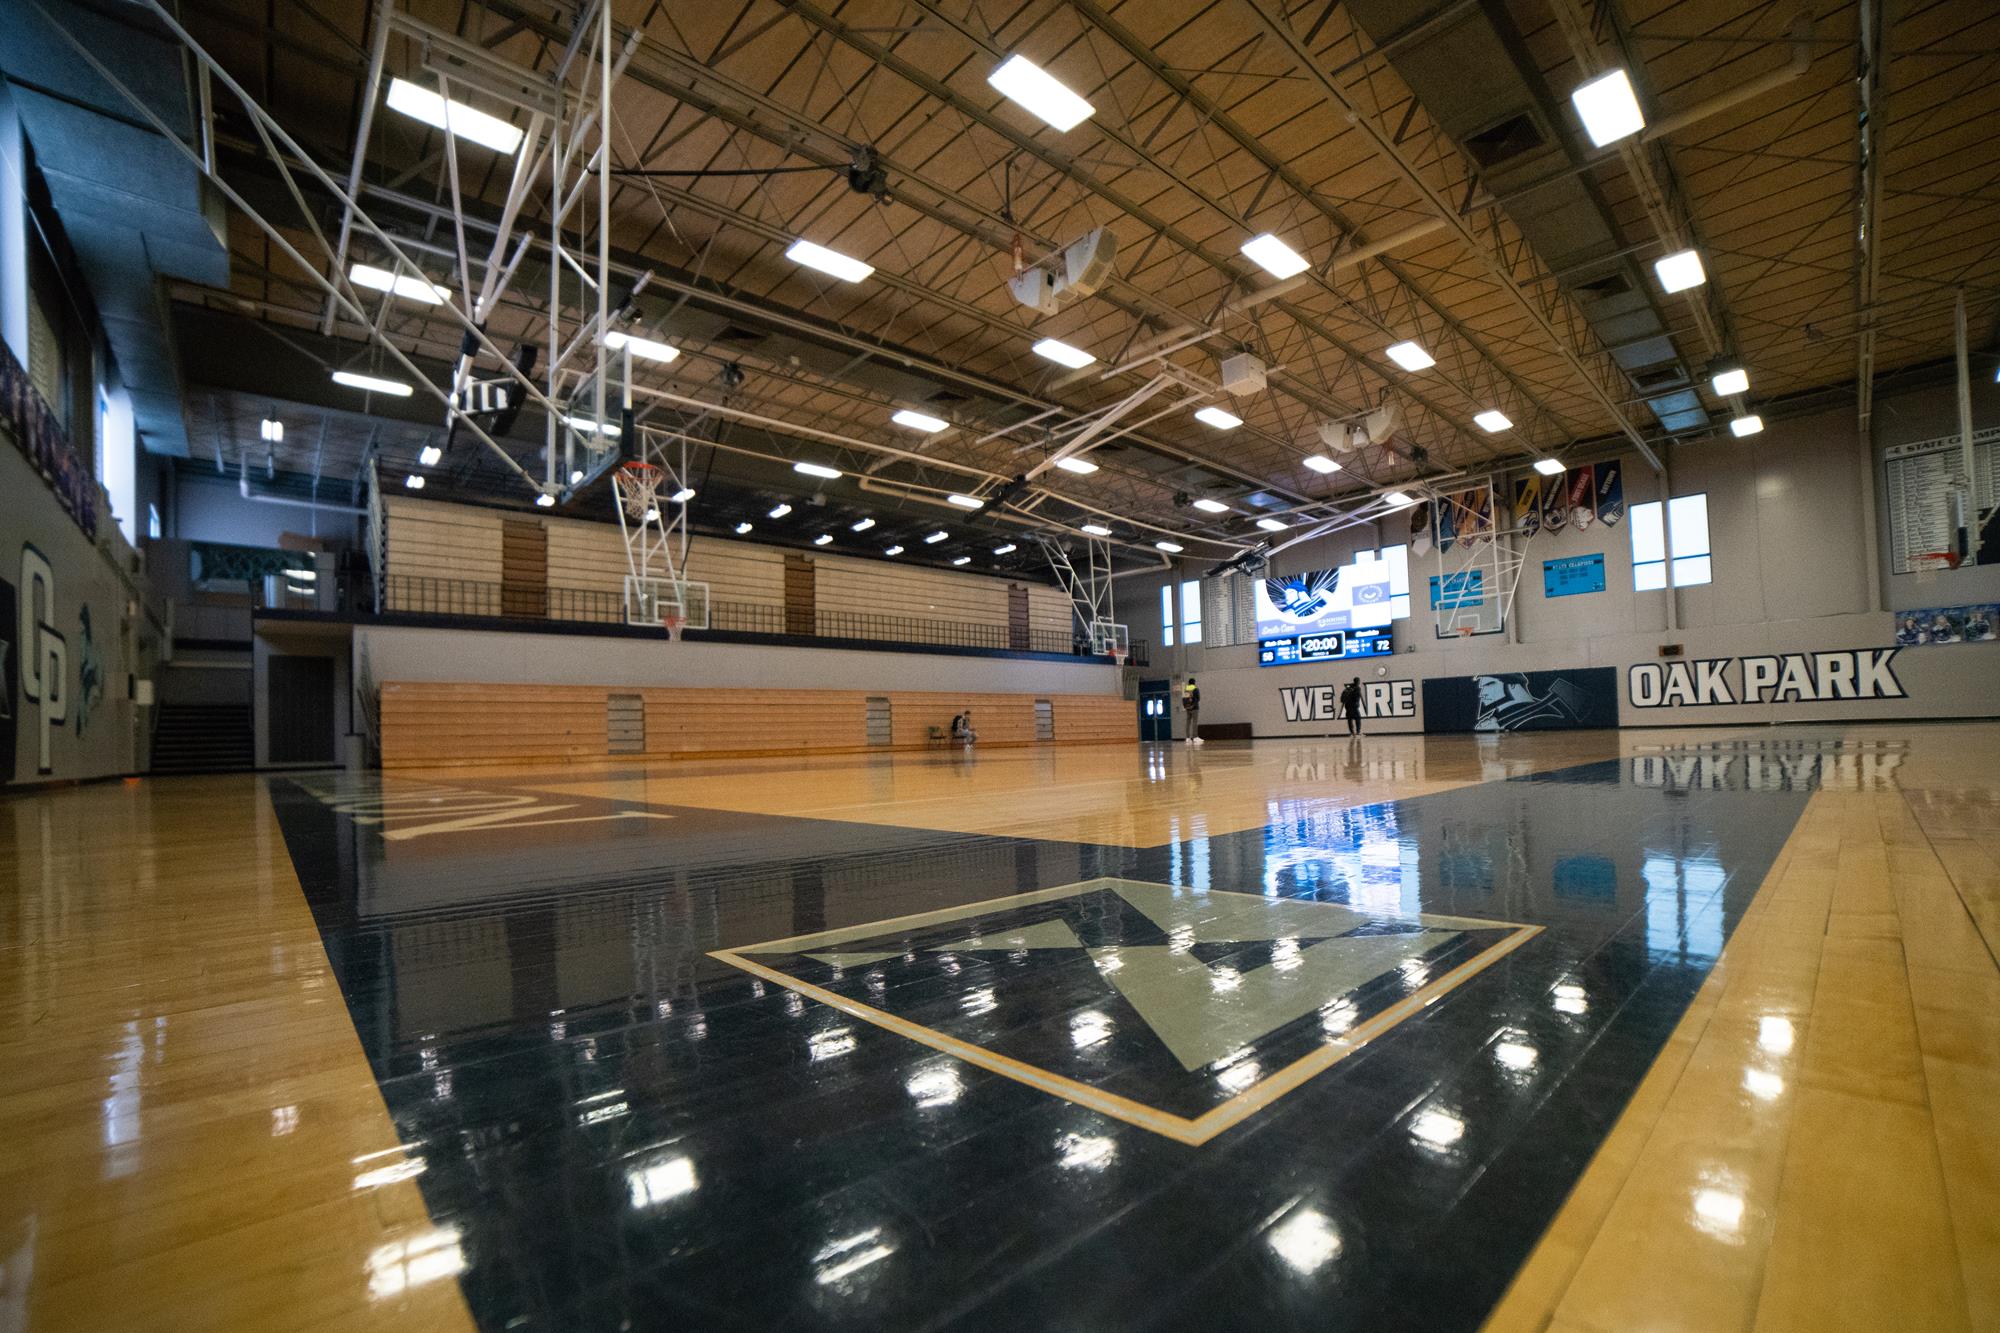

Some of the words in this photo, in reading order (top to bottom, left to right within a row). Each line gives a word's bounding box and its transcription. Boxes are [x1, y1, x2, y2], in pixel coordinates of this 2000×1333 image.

[1907, 440, 1943, 451] STATE
[1376, 640, 1390, 650] 72
[1628, 658, 1738, 708] OAK
[1738, 647, 1909, 704] PARK
[1279, 685, 1335, 722] WE
